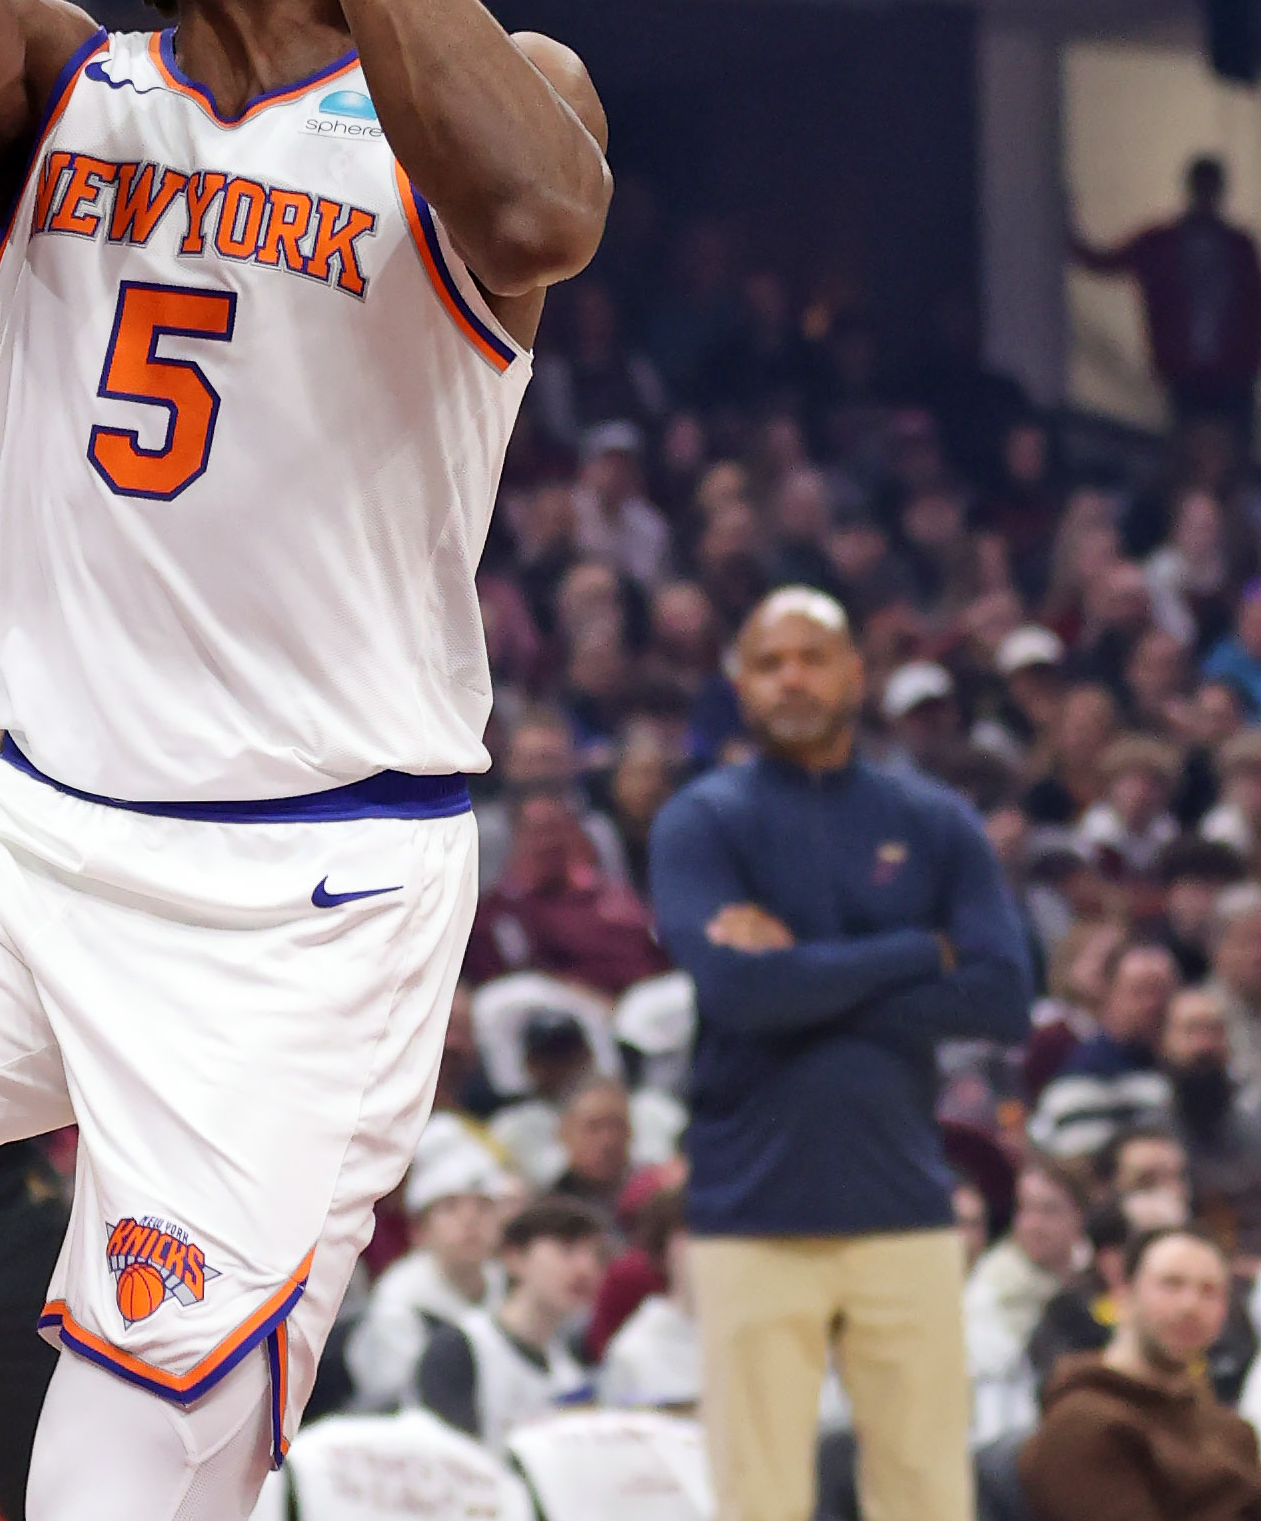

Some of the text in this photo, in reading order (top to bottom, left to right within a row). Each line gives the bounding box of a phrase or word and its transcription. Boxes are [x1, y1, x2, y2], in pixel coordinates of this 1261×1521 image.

[305, 118, 384, 138] sphere
[87, 280, 238, 502] 5
[106, 1217, 205, 1301] KNICKS
[165, 1221, 188, 1244] YORK
